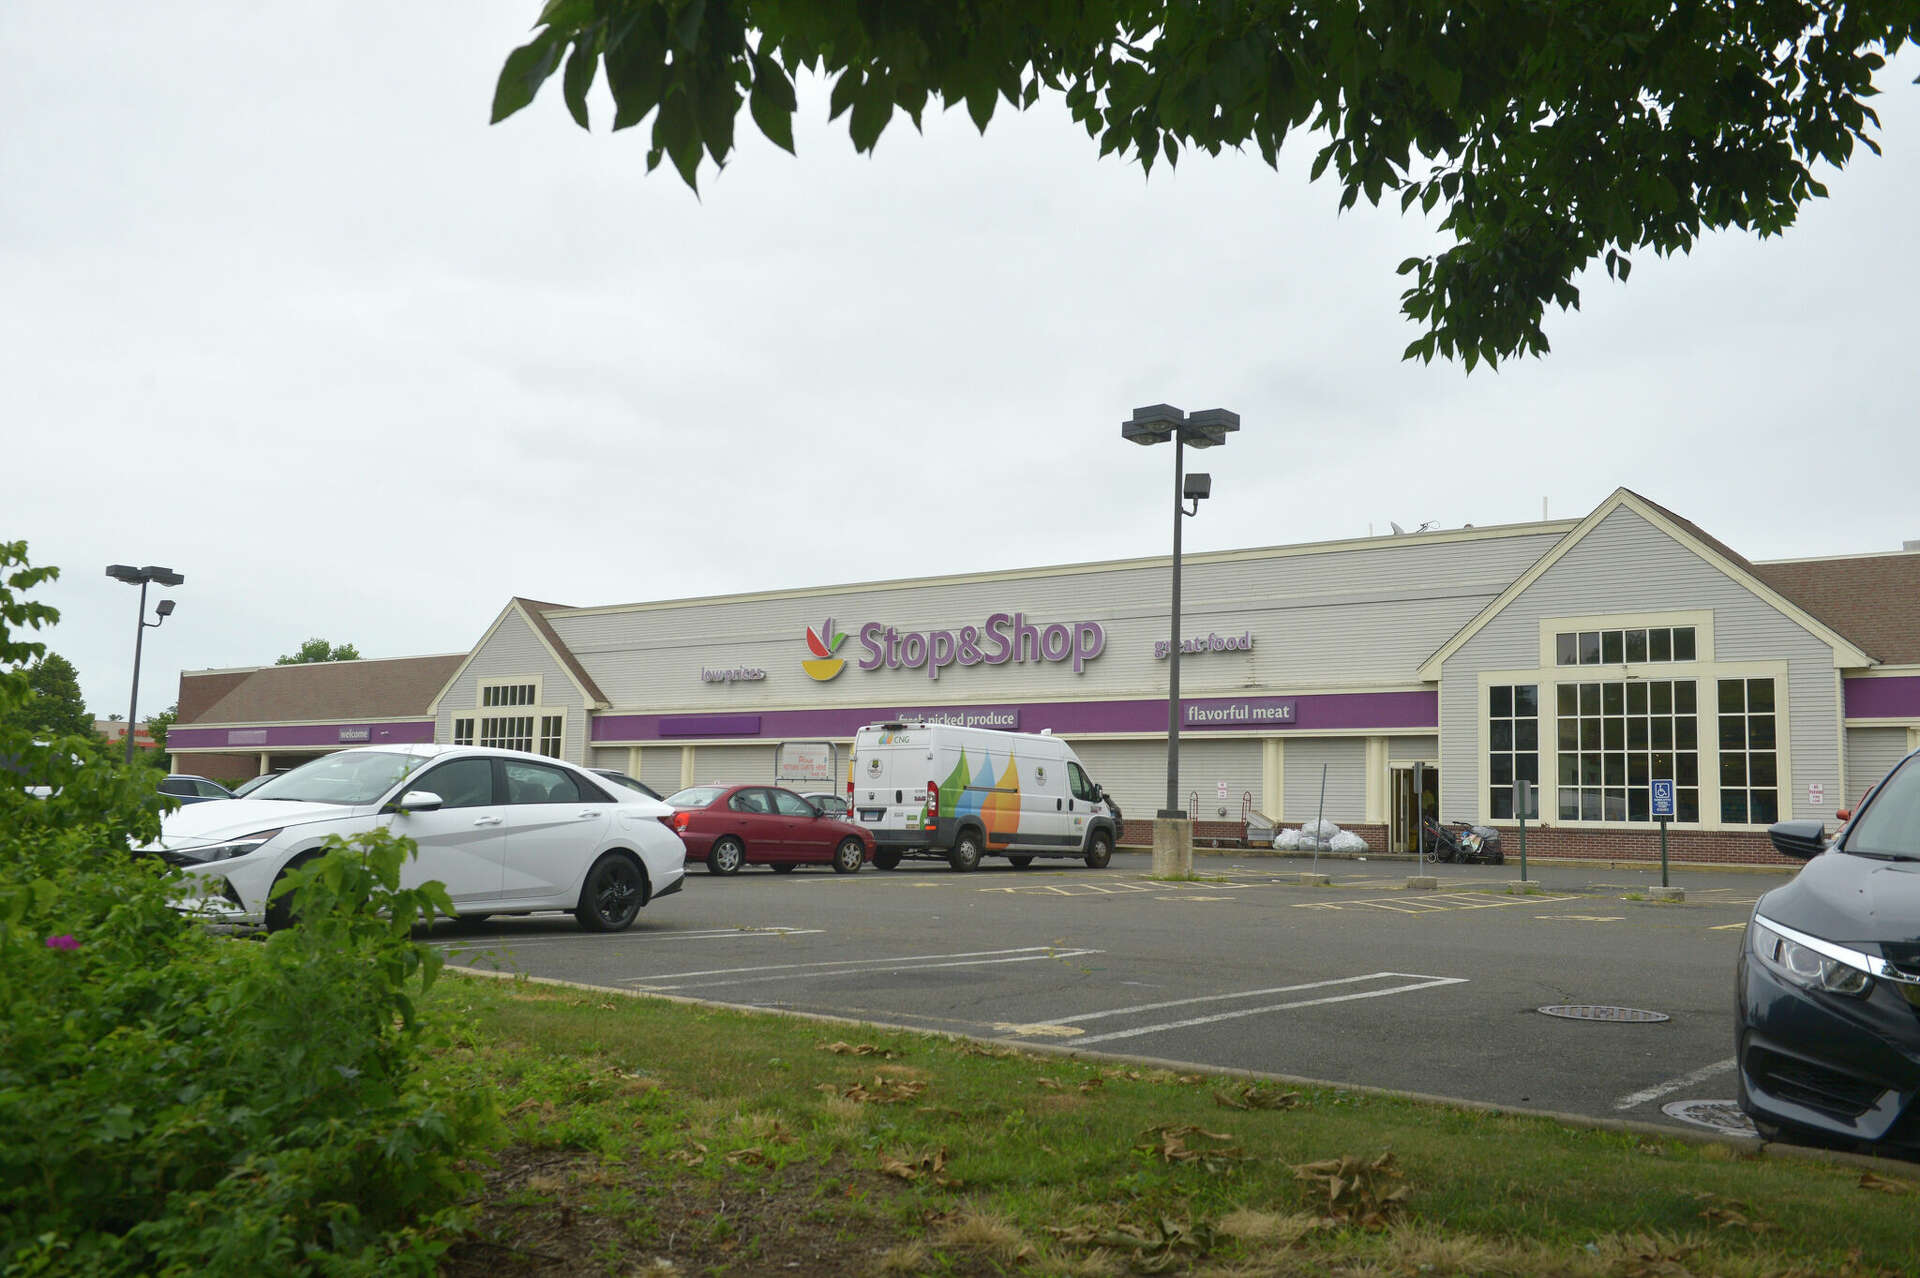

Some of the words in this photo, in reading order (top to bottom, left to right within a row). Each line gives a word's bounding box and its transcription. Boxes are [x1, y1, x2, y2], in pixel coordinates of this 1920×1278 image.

[858, 612, 1106, 680] Stop&Shop
[1154, 636, 1202, 659] grat
[1208, 631, 1251, 651] food
[967, 712, 1014, 728] produce
[1188, 704, 1249, 721] flavorful
[1252, 705, 1290, 719] meat
